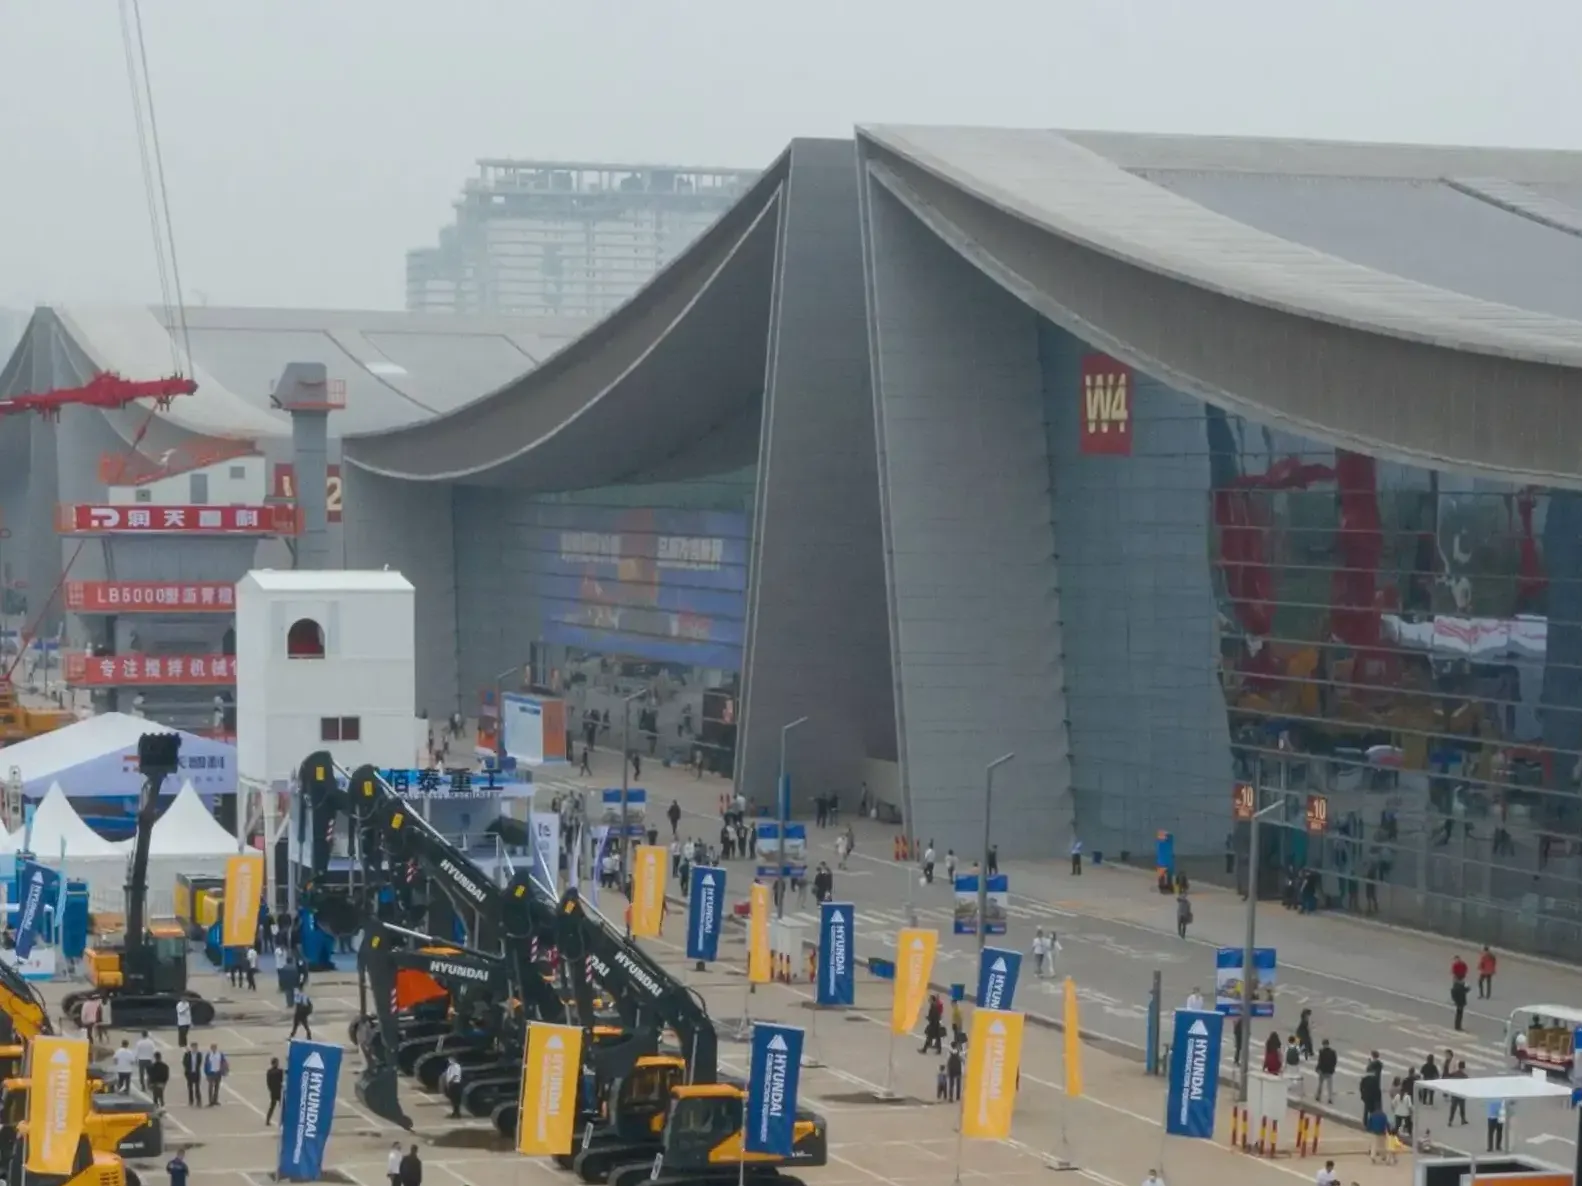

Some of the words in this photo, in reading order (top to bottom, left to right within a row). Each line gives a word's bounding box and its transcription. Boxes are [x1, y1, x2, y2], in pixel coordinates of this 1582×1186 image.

[1085, 373, 1128, 433] W4
[440, 859, 487, 903] HYUNDAI
[704, 887, 715, 933] HYUNDAI
[429, 960, 490, 982] HYUNDAI
[614, 951, 664, 998] HYUNDAI
[836, 925, 846, 975] HYUNDAI
[770, 1053, 788, 1117] HYUNDAI
[1190, 1039, 1208, 1100] HYUNDAI
[304, 1072, 324, 1138] HYUNDAI
